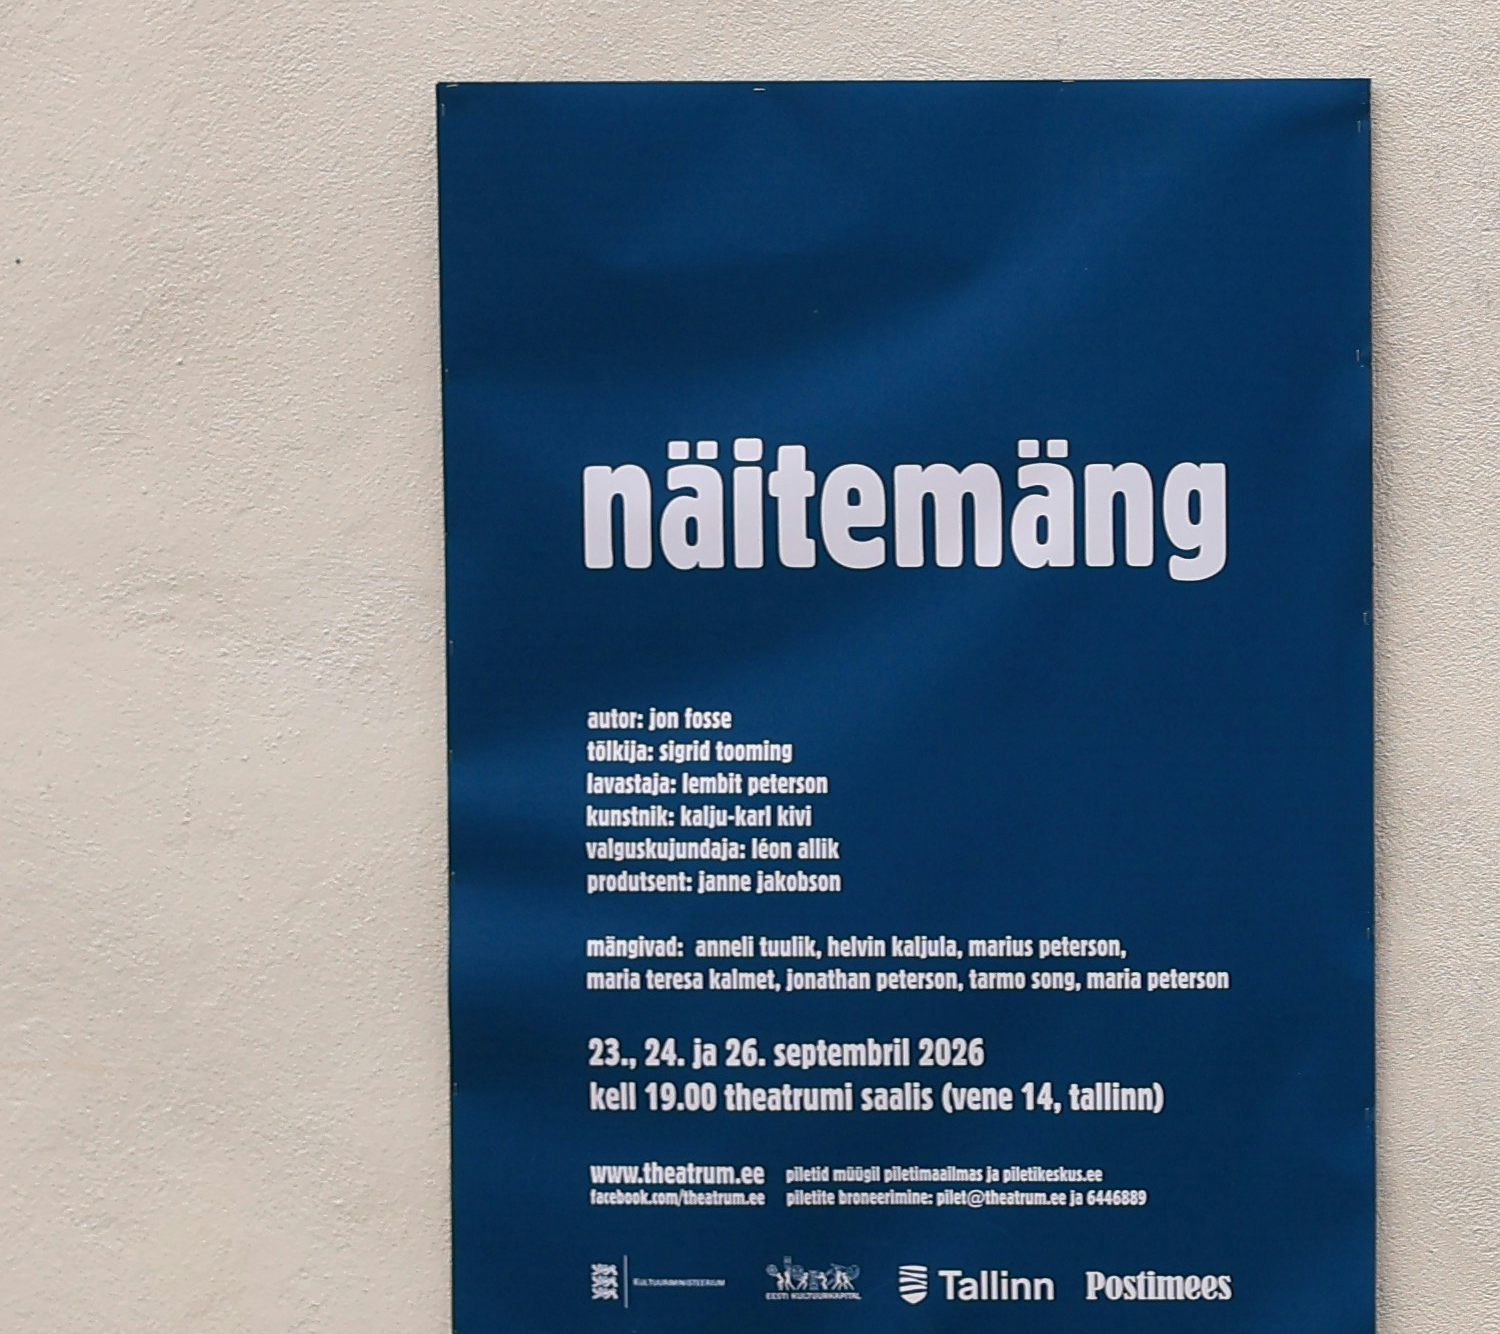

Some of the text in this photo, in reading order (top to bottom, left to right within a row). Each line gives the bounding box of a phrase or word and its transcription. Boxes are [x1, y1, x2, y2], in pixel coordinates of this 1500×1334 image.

[582, 437, 1227, 582] näitemäng
[586, 706, 733, 732] autor: jon fosse
[586, 739, 793, 764] tõlkija: sigrid tooming
[586, 771, 829, 797] lavastaja: lembit peterson
[585, 804, 812, 830] kunstnik: kalju-karl kivi
[585, 837, 841, 862] valguskujundaja: léon allik
[586, 869, 842, 895] produtsent: janne jakobson
[586, 934, 1127, 960] mängivad: anneli tuulik, helvin kaljula, marius peterson,
[586, 967, 1230, 993] maria teresa kalmet, jonathan peterson, tarmo song, maria peterson
[587, 1037, 985, 1070] 23., 24. ja 26. septembril 2026
[589, 1081, 1165, 1115] kell 19.00 theatrumi saalis (vene 14, tallinn)
[589, 1161, 766, 1185] www.theatrum.ee
[785, 1165, 1104, 1184] piletid müügil piletimaailmas ja piletikeskus.ee
[589, 1188, 766, 1207] facebook.com/theatrum.ee
[785, 1188, 1148, 1209] piletite broneerimine: pilet@theatrum.ee ja 6446889
[937, 1269, 1055, 1301] Tallinn
[1085, 1270, 1233, 1301] Postimees
